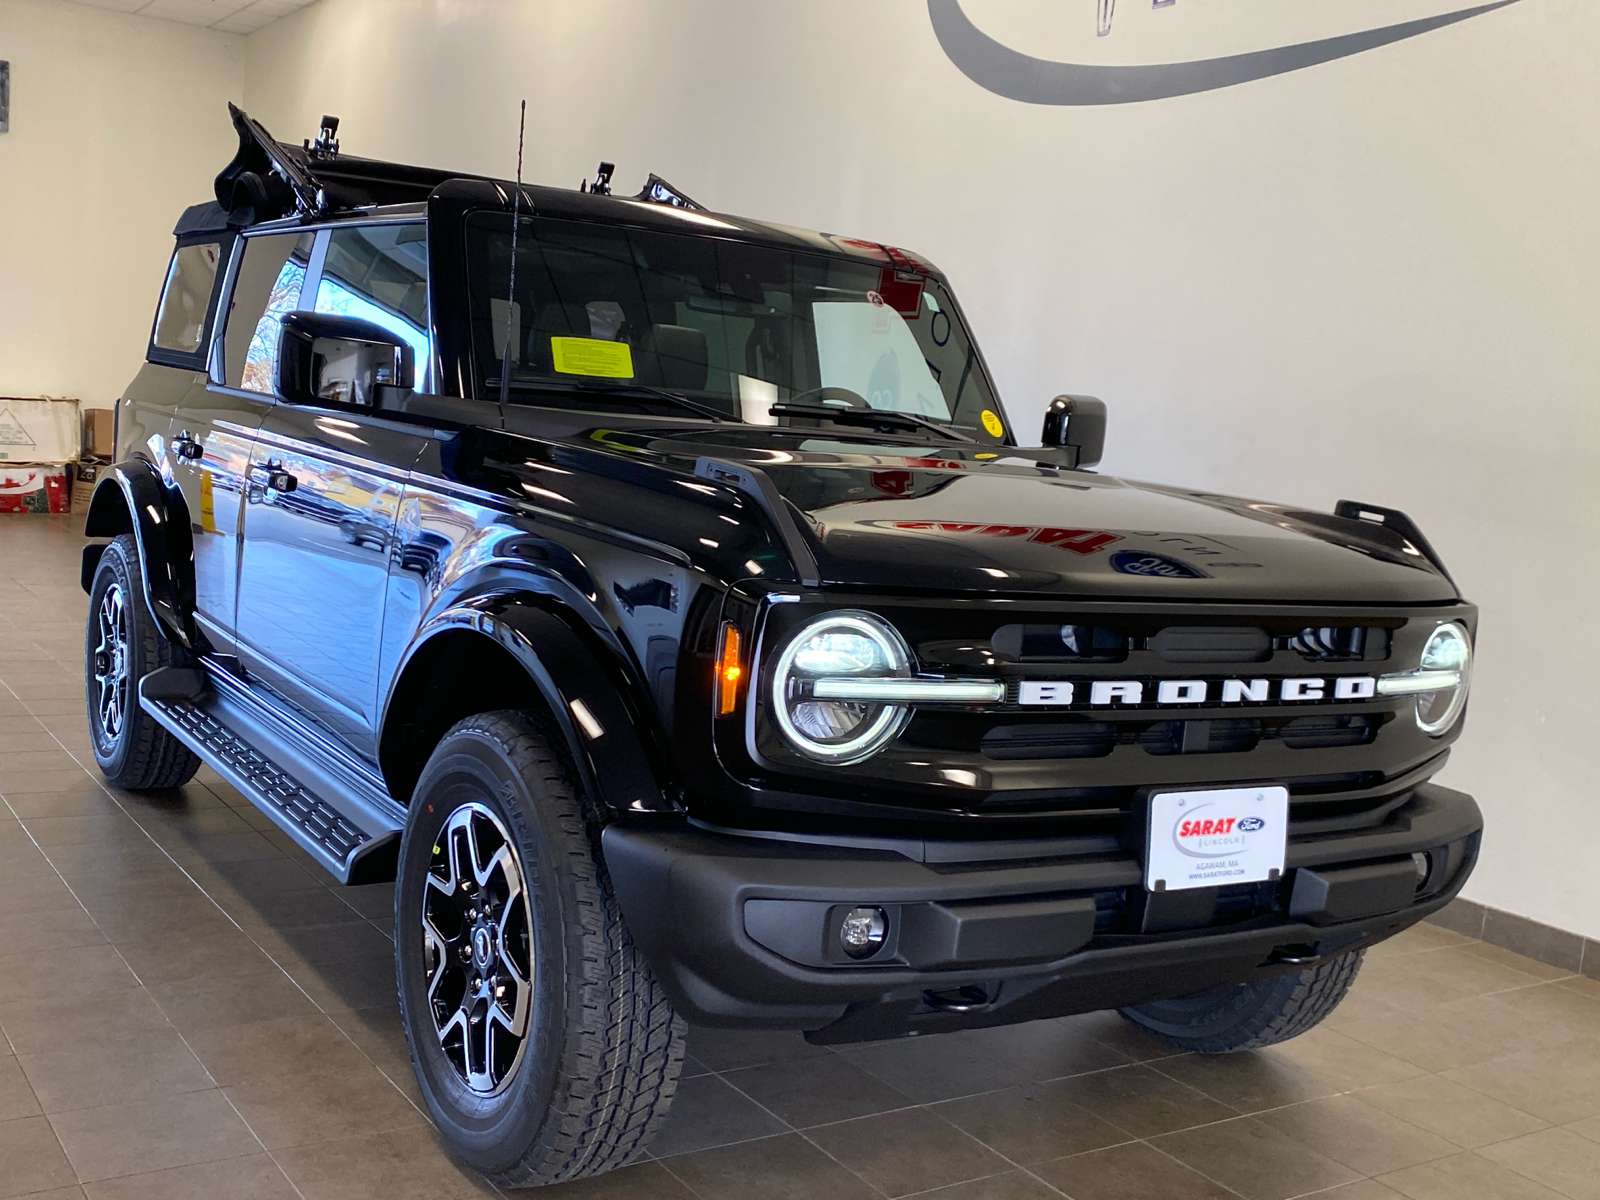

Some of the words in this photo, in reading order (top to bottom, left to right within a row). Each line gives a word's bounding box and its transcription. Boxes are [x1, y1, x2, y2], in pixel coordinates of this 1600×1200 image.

[869, 292, 884, 306] 25
[1018, 676, 1375, 705] BRONCO
[1179, 817, 1236, 838] SARAT
[1241, 818, 1262, 832] Ford
[1203, 837, 1240, 847] LINCOLN
[1195, 861, 1227, 871] AGAWAM,
[1228, 860, 1239, 868] MA
[1188, 868, 1245, 880] WWW.SARATFORD.COM
